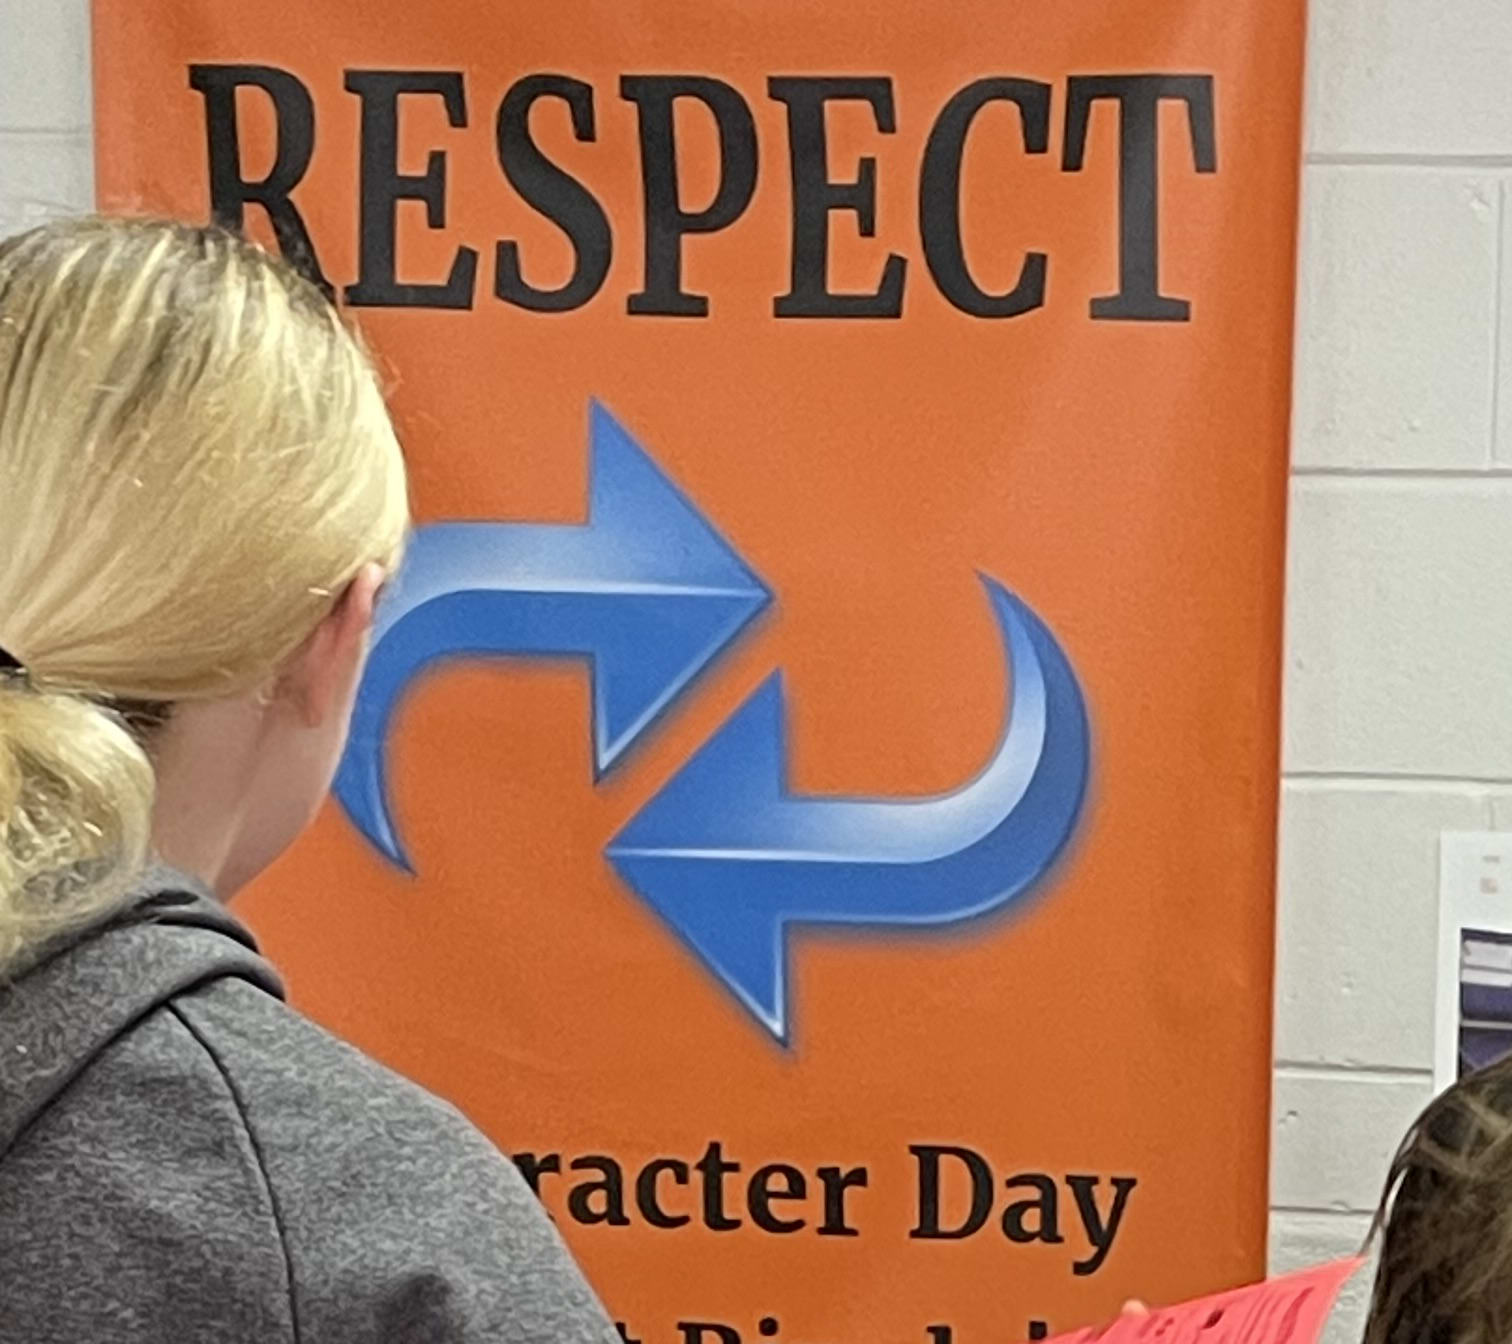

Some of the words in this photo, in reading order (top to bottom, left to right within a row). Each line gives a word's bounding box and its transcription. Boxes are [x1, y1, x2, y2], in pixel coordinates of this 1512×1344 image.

[187, 62, 1217, 322] RESPECT
[512, 1140, 869, 1238] racter
[907, 1144, 1138, 1277] Day
